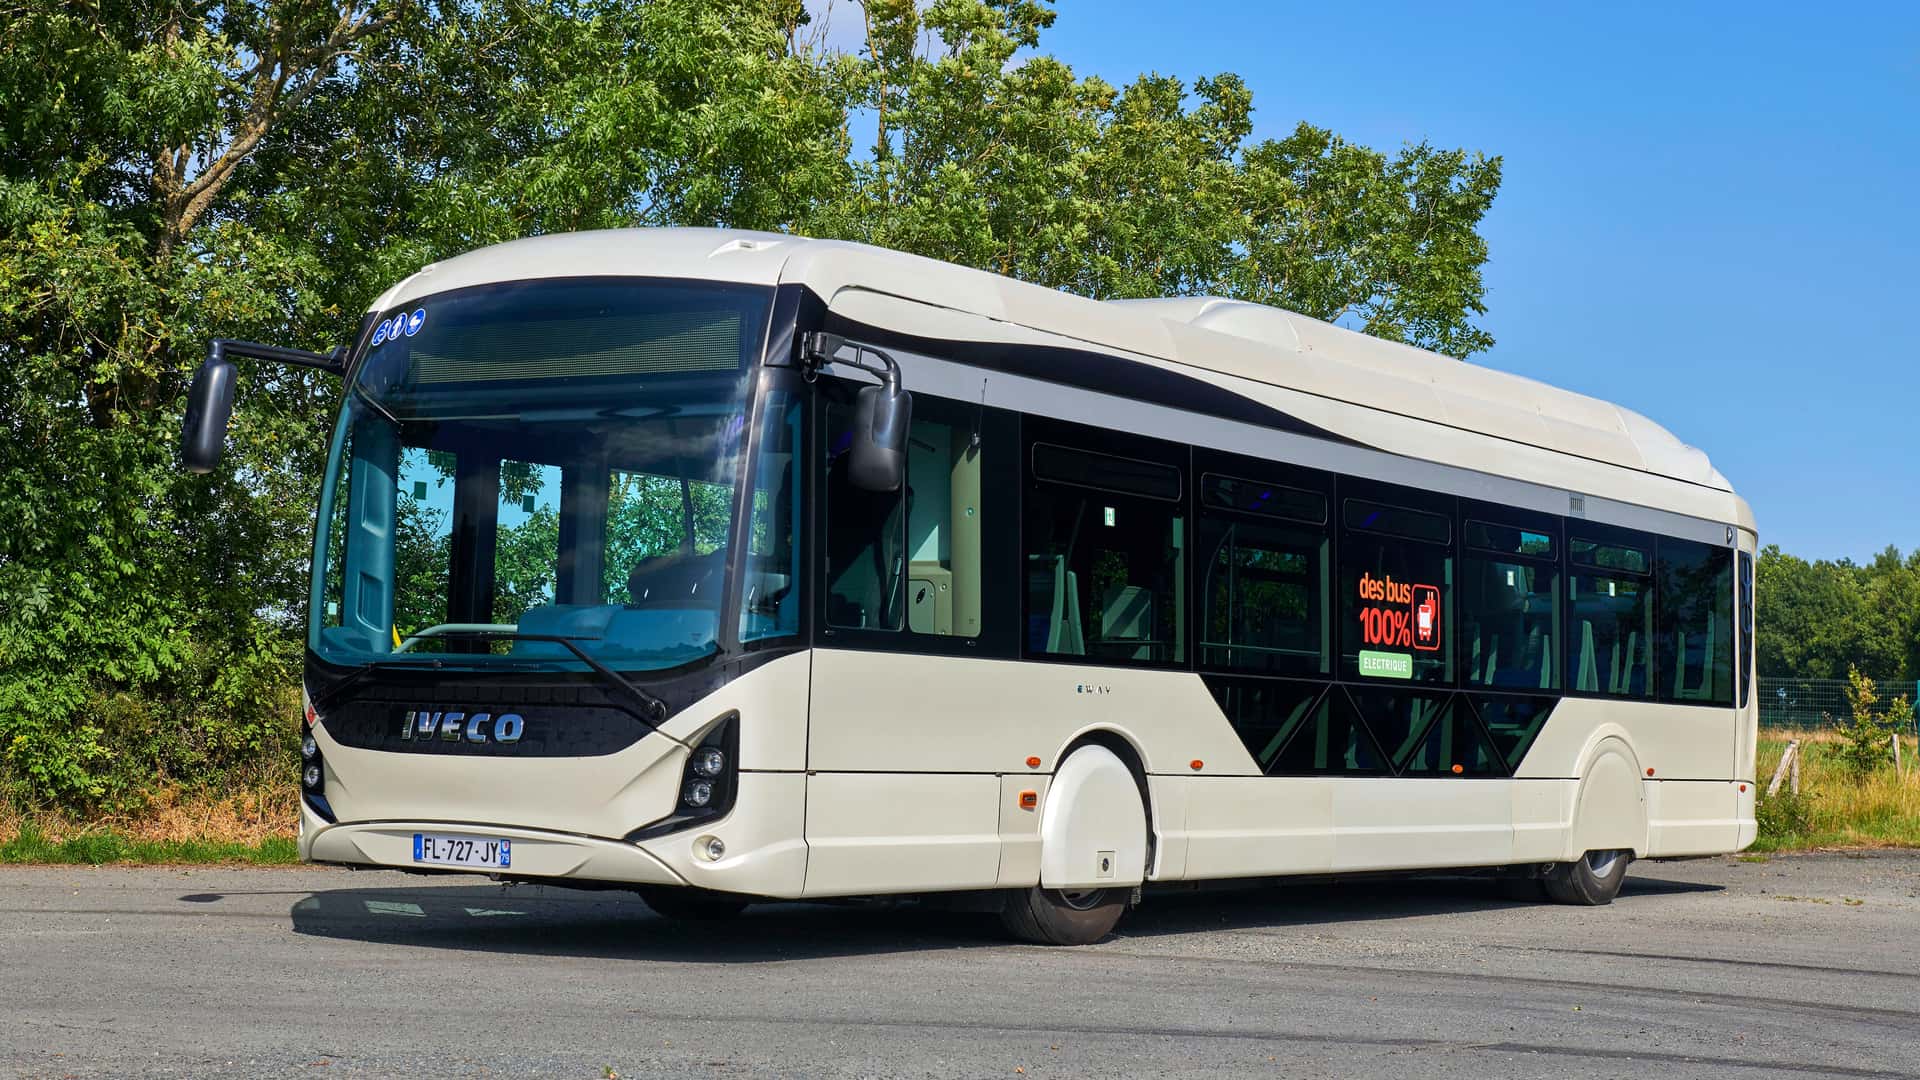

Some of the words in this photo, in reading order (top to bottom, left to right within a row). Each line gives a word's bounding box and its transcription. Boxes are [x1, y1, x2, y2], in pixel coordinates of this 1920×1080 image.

[1359, 572, 1384, 601] des
[1386, 575, 1411, 604] bus
[1359, 607, 1411, 647] 100%
[401, 711, 525, 744] IVECO
[423, 838, 498, 863] FL-727-JY
